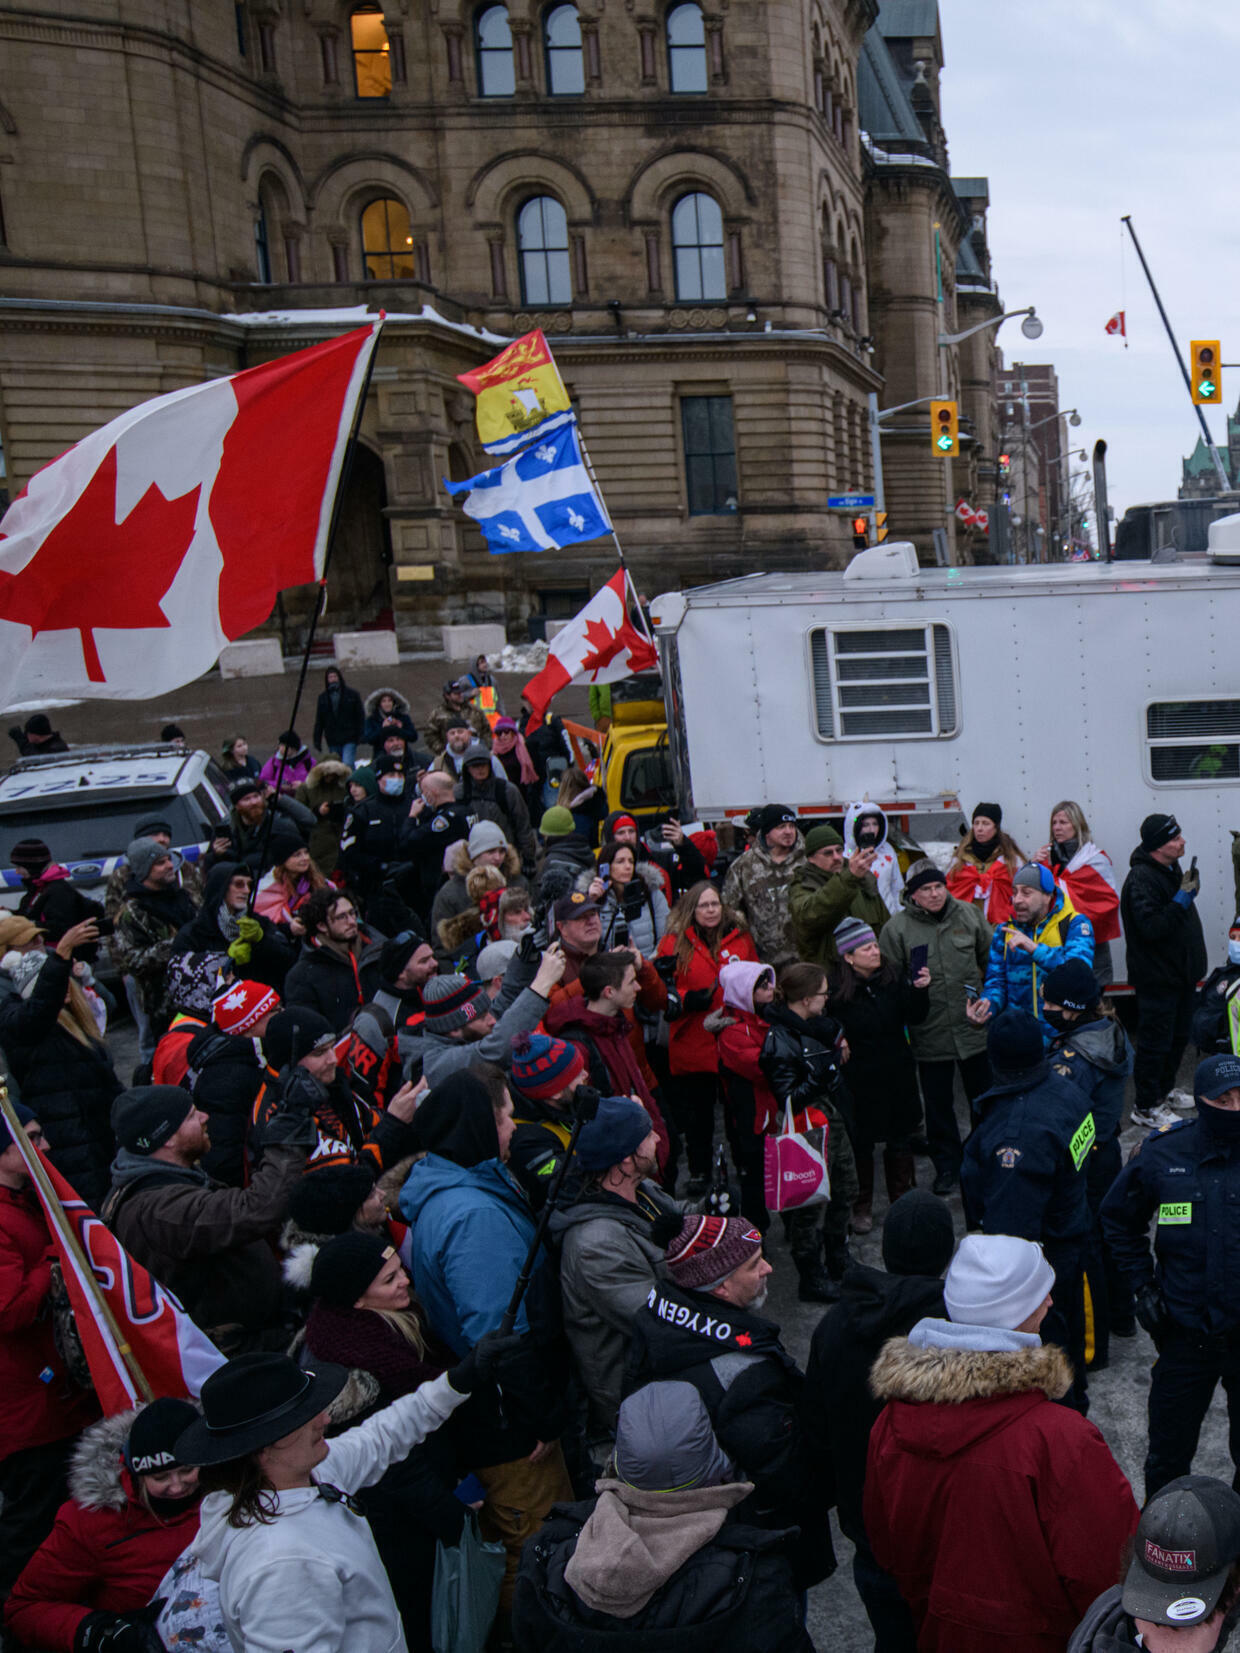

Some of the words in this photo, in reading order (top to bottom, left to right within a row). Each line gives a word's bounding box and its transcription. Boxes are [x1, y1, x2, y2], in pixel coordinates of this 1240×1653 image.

[228, 996, 277, 1036] CANADA
[1072, 1119, 1094, 1154] POLICE
[1160, 1205, 1188, 1217] POLICE
[657, 1297, 732, 1341] OXYGEN
[131, 1450, 176, 1473] CANA
